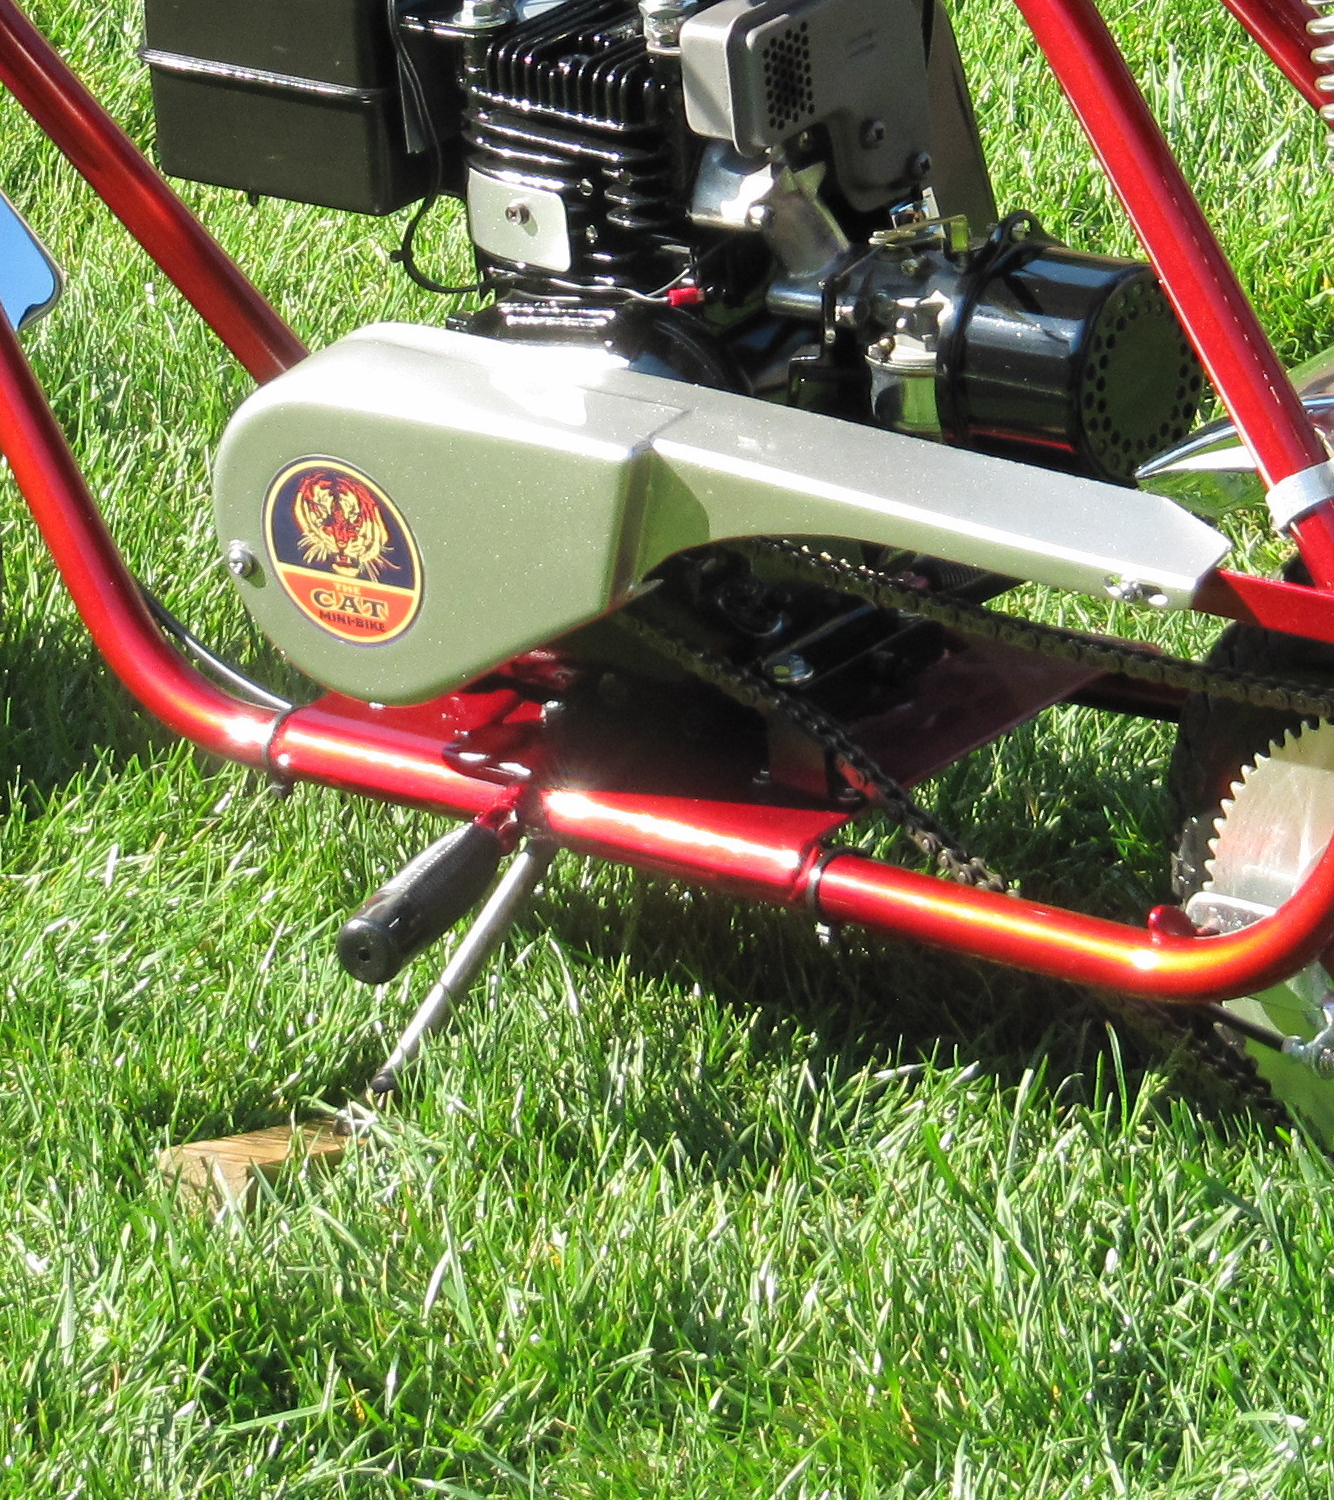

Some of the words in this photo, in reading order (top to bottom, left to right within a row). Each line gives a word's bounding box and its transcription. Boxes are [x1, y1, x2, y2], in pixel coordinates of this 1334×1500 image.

[332, 582, 362, 596] THE
[310, 588, 389, 621] CAT
[319, 610, 386, 632] MINI-BIKE
